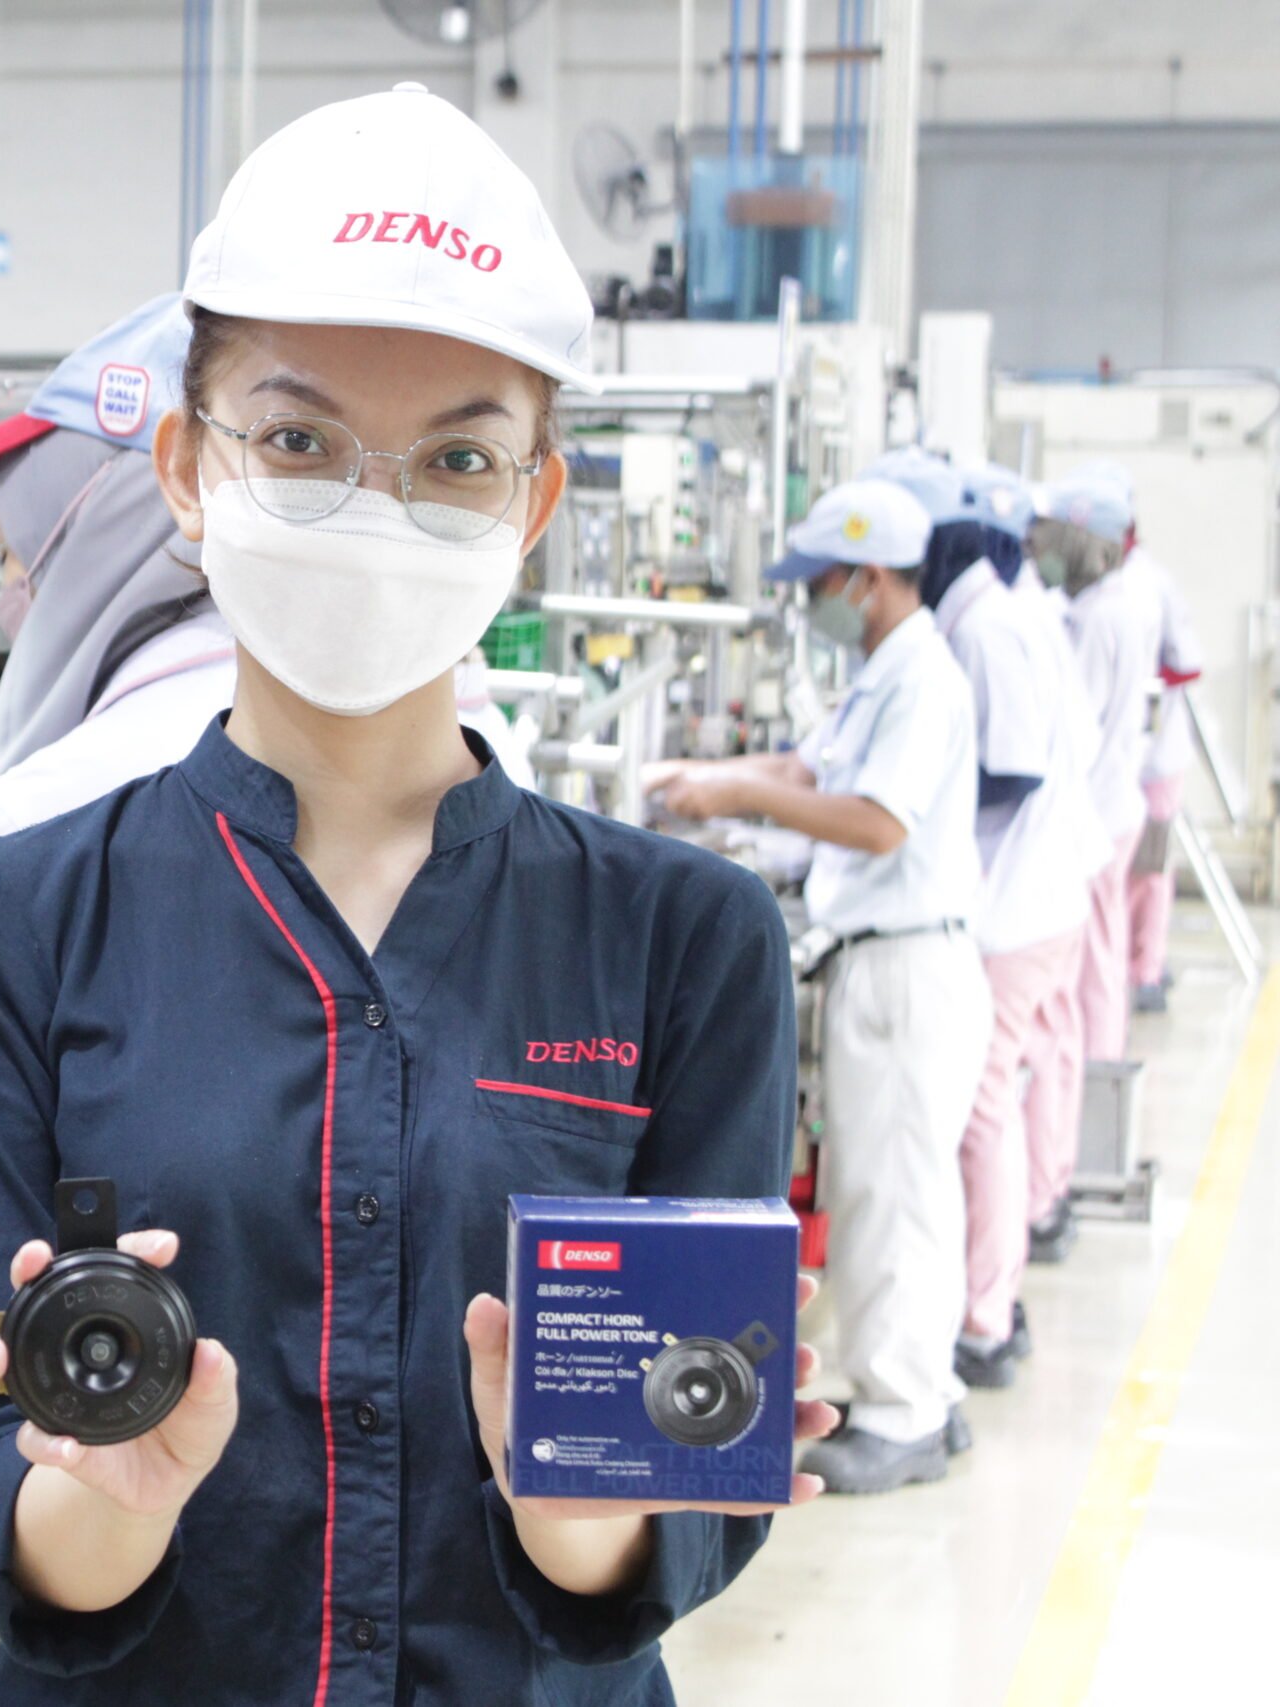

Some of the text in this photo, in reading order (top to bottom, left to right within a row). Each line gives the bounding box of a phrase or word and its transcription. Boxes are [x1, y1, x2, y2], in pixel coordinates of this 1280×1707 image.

[333, 211, 502, 272] DENSO
[108, 373, 142, 386] STOP
[106, 387, 138, 402] CALL
[104, 401, 137, 416] WAIT
[526, 1038, 638, 1067] DENSO
[564, 1250, 613, 1261] DENSO
[536, 1283, 623, 1298] 品質のデンソー
[536, 1312, 644, 1327] COMPACT HORN
[536, 1327, 658, 1343] FULL POWER TONE
[575, 1367, 614, 1378] Klakson
[617, 1368, 639, 1379] Disc
